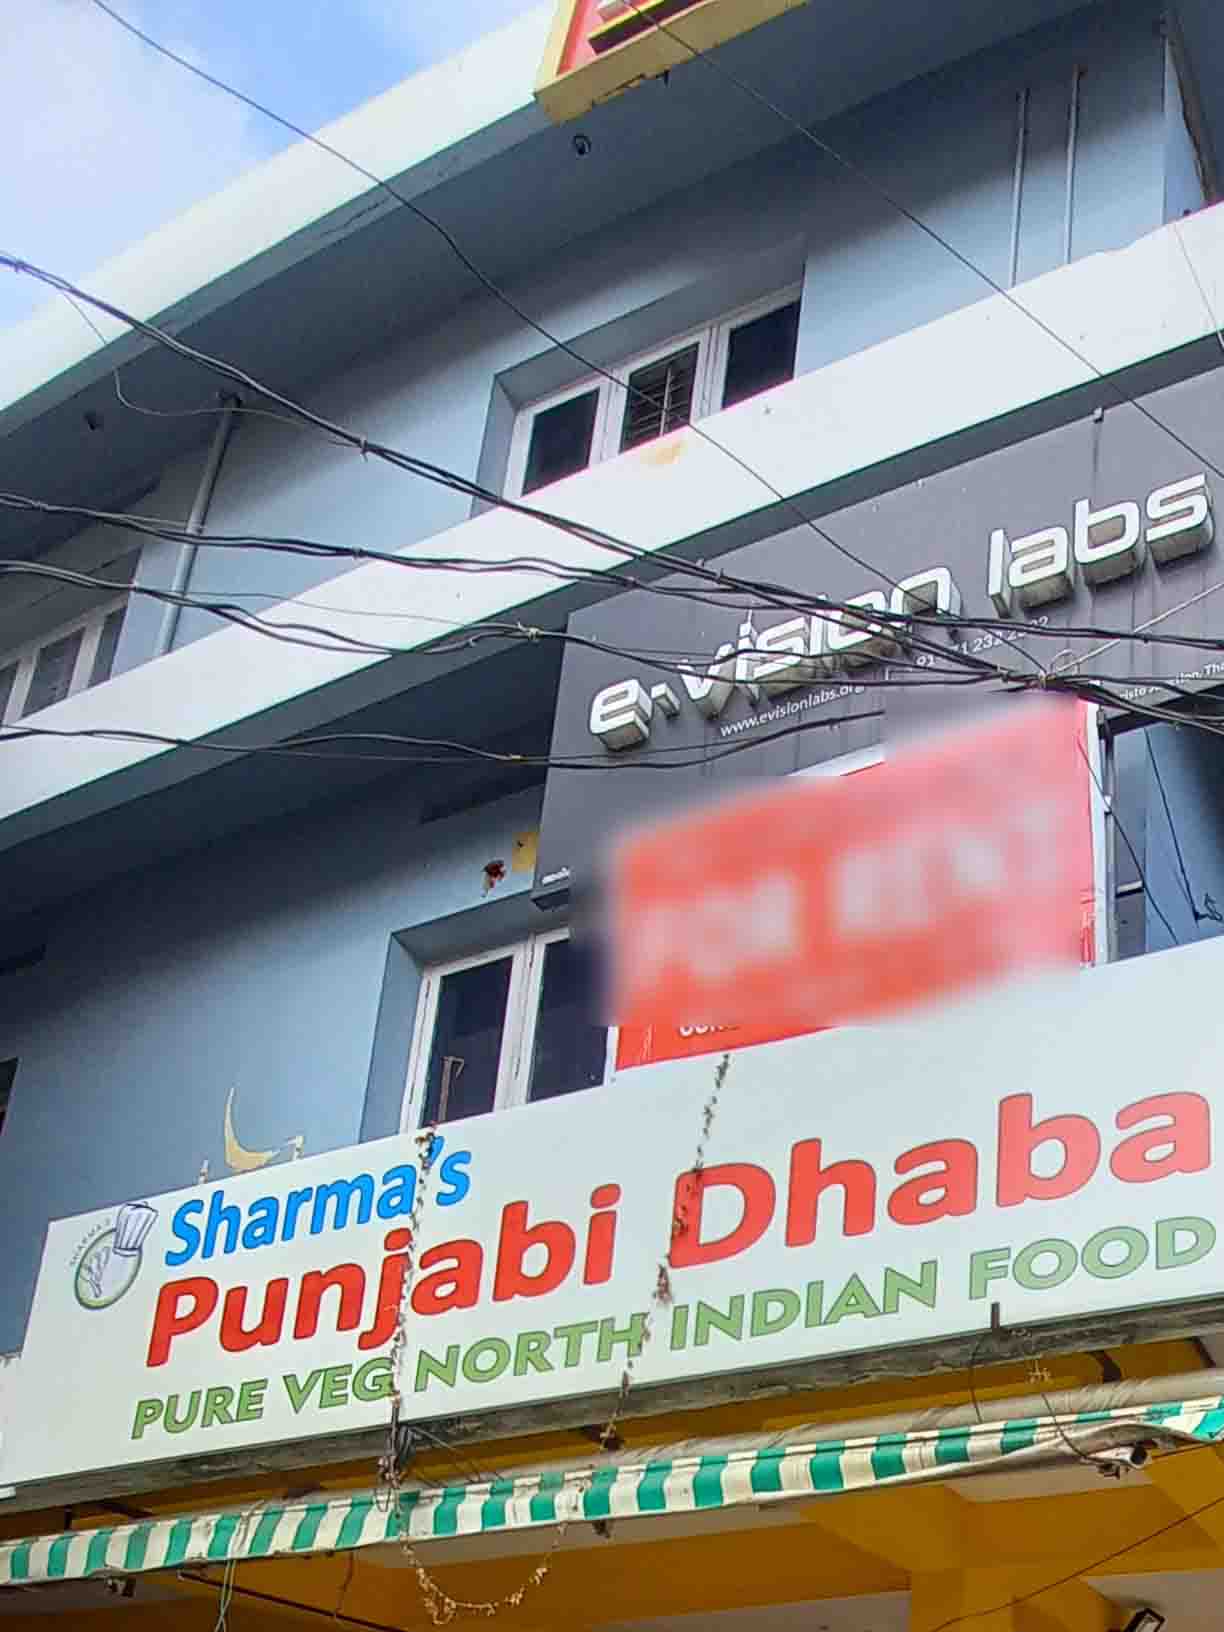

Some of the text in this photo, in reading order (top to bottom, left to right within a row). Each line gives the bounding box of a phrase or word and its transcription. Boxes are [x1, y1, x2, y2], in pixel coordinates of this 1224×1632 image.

[987, 471, 1214, 606] labs
[146, 1091, 1211, 1368] Punjabi Dhaba
[164, 1134, 473, 1267] Sharma's
[131, 1215, 1218, 1440] PURE VEG NORTH INDIAN FOOD
